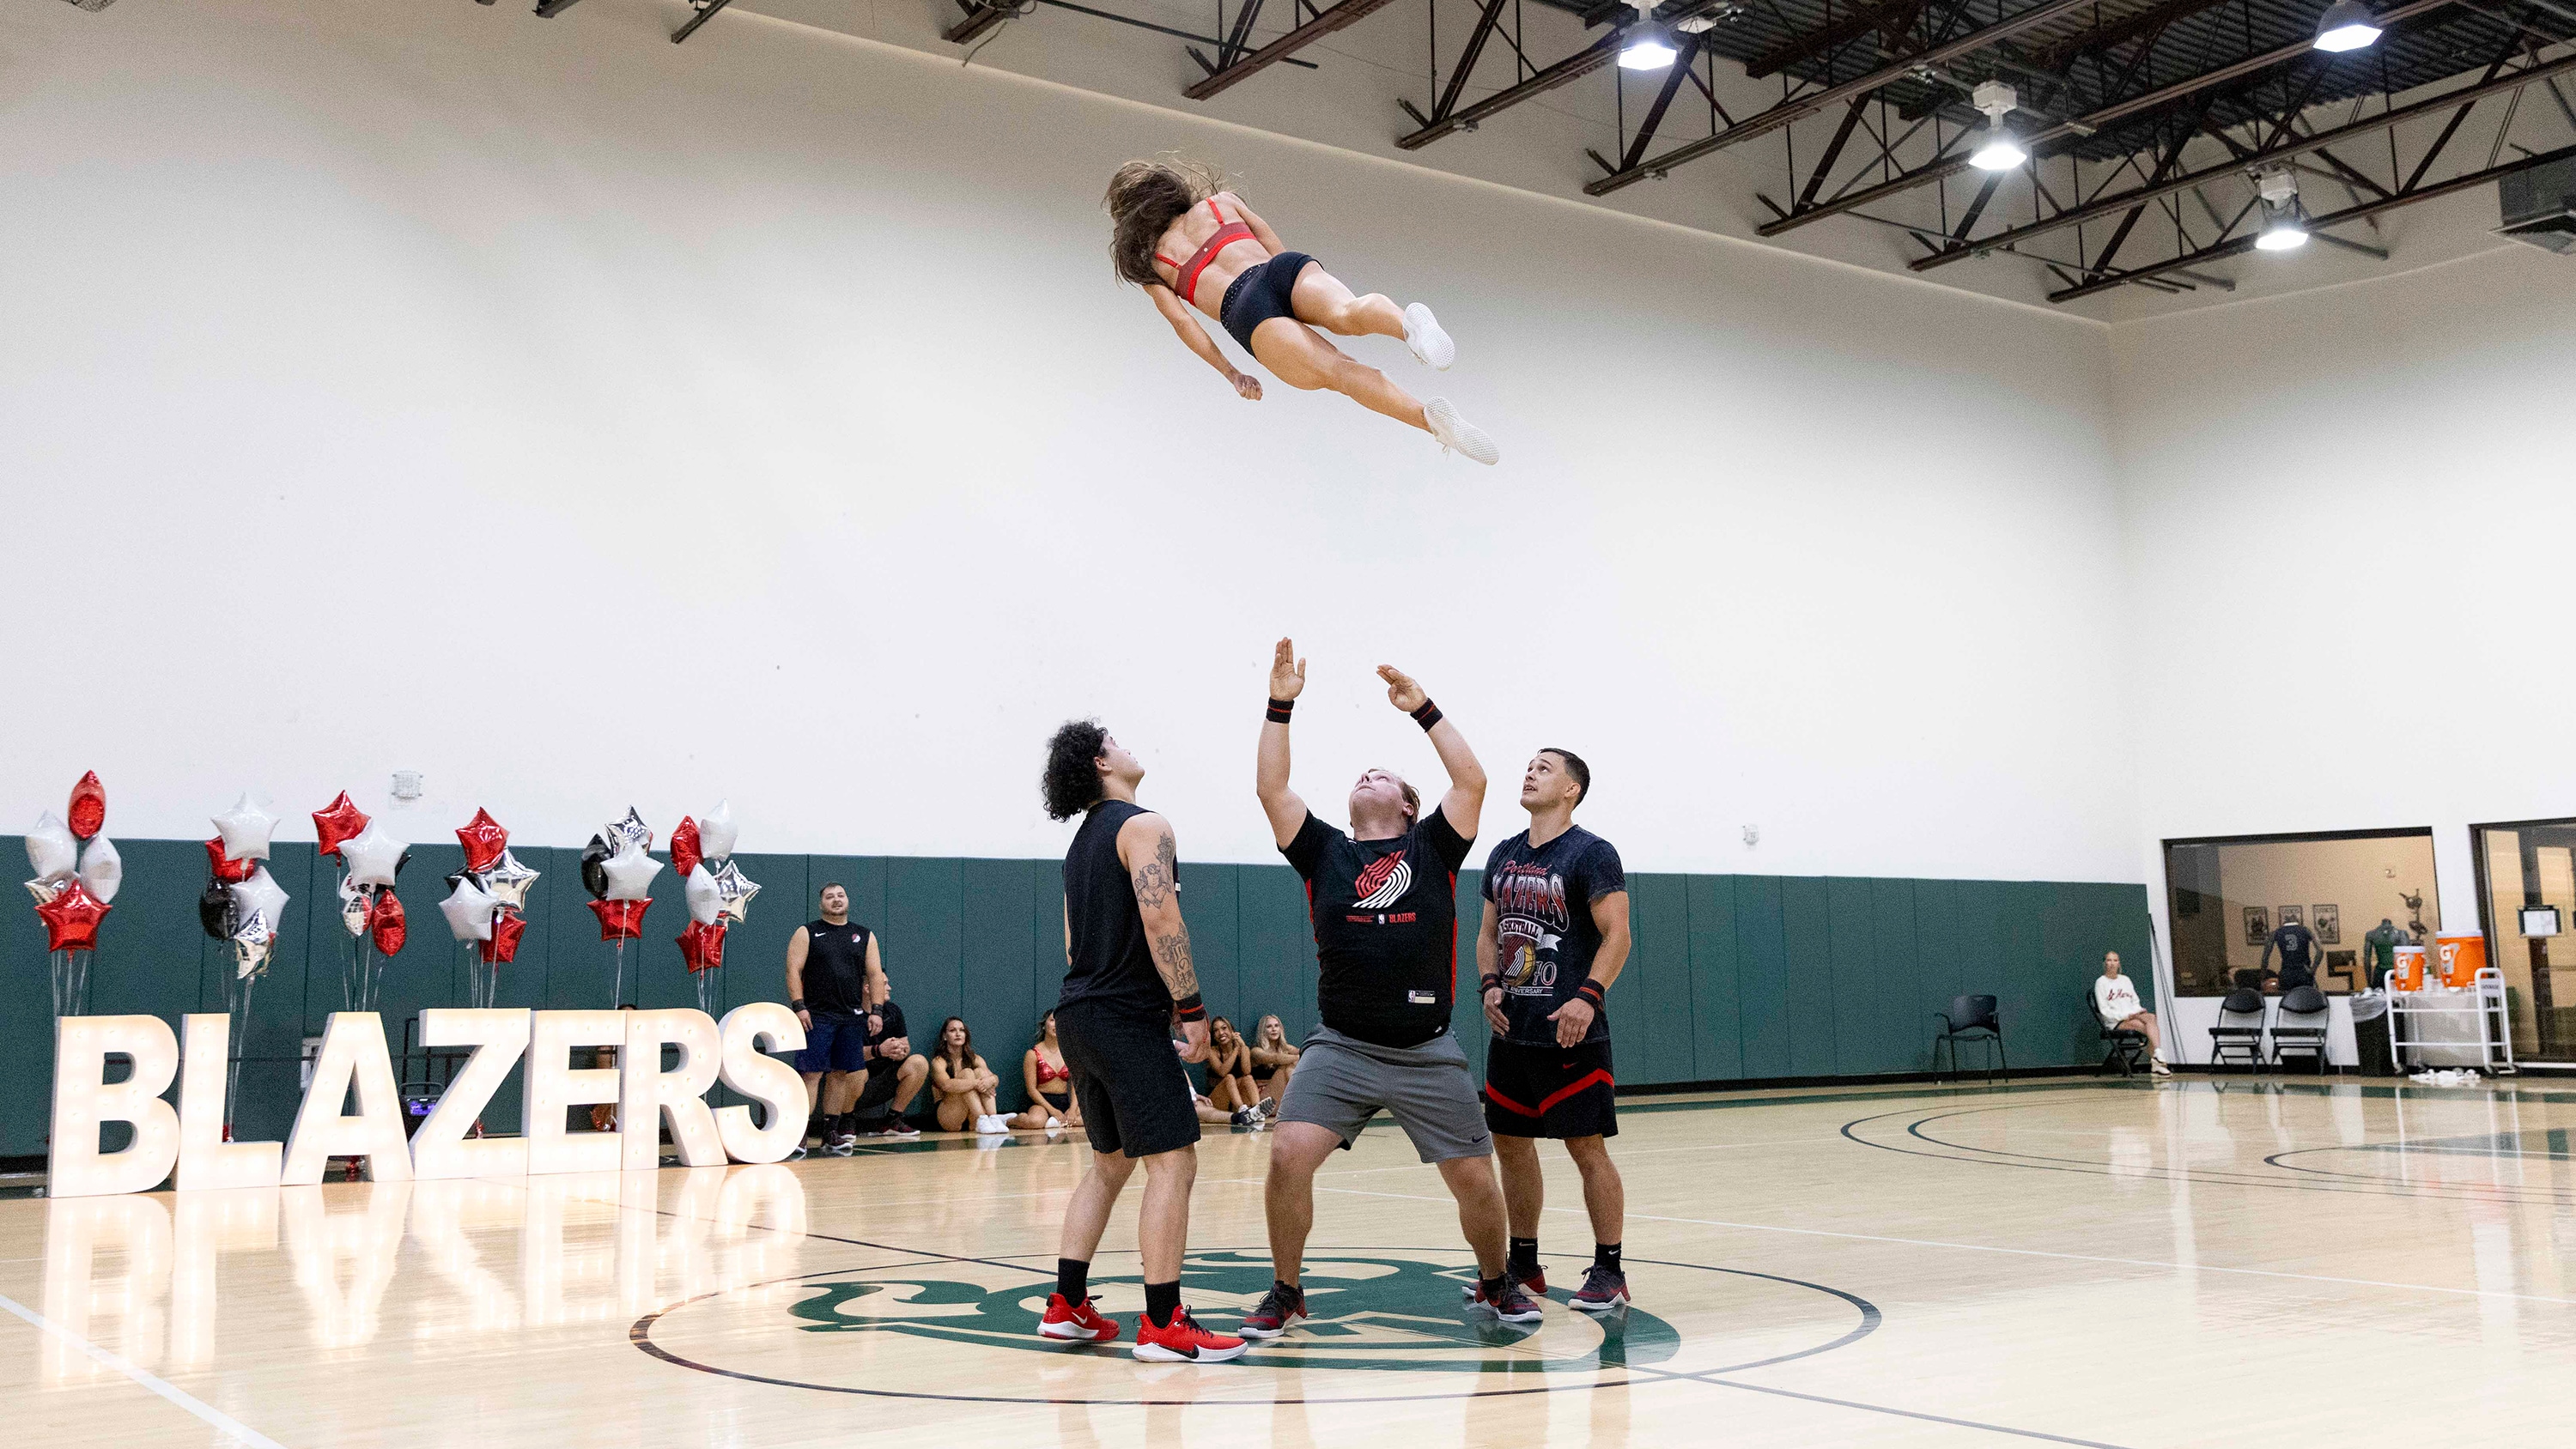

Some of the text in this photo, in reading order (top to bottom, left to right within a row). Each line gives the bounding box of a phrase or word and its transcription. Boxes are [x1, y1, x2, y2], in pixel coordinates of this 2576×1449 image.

[1504, 860, 1552, 876] Portland
[1388, 912, 1416, 924] BLAZERS
[2285, 934, 2298, 951] 3
[48, 1002, 808, 1197] BLAZERS
